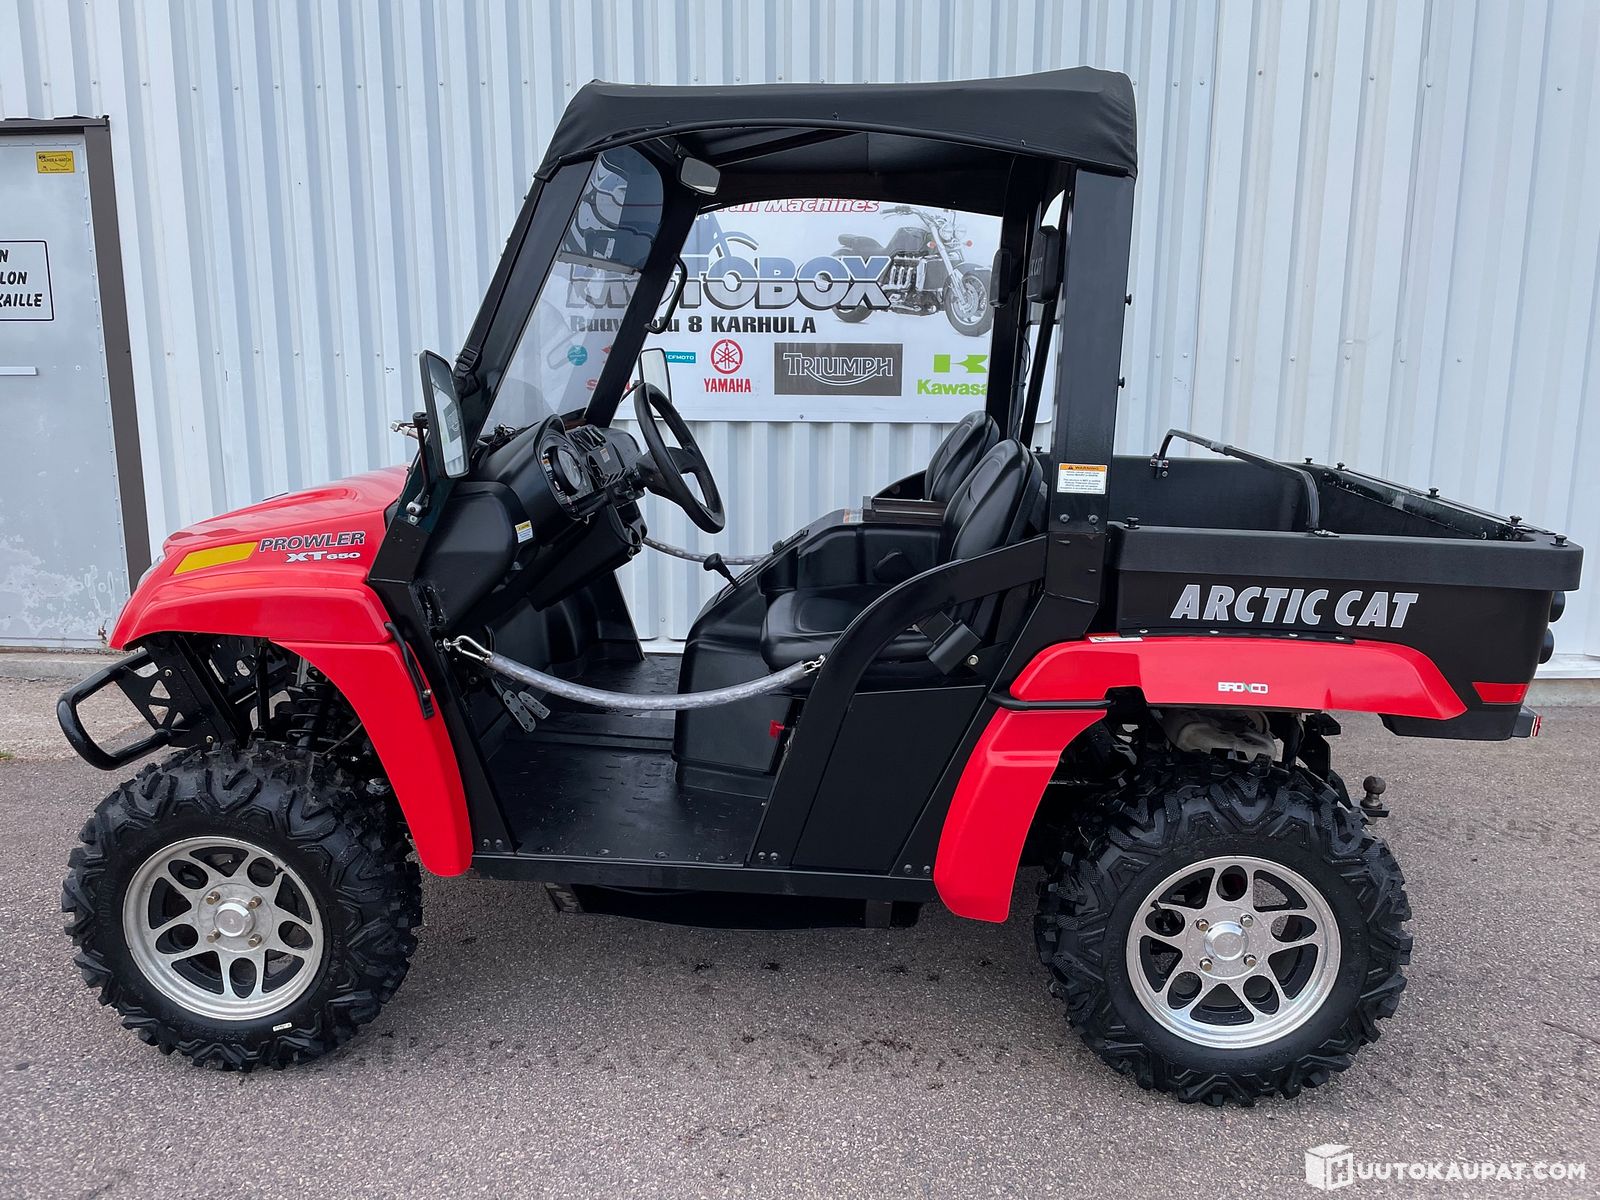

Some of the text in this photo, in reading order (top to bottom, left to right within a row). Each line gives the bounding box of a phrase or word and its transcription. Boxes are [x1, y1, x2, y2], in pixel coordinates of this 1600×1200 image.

[765, 198, 881, 213] Machines
[566, 252, 892, 311] MTOBOX
[688, 315, 703, 333] 8
[711, 315, 817, 334] KARHULA
[782, 352, 894, 378] TRIUMPH
[703, 378, 752, 393] YAMAHA
[259, 531, 366, 552] PROWLER
[1169, 584, 1420, 629] ARCTIC CAT
[1217, 681, 1269, 694] BRONCO
